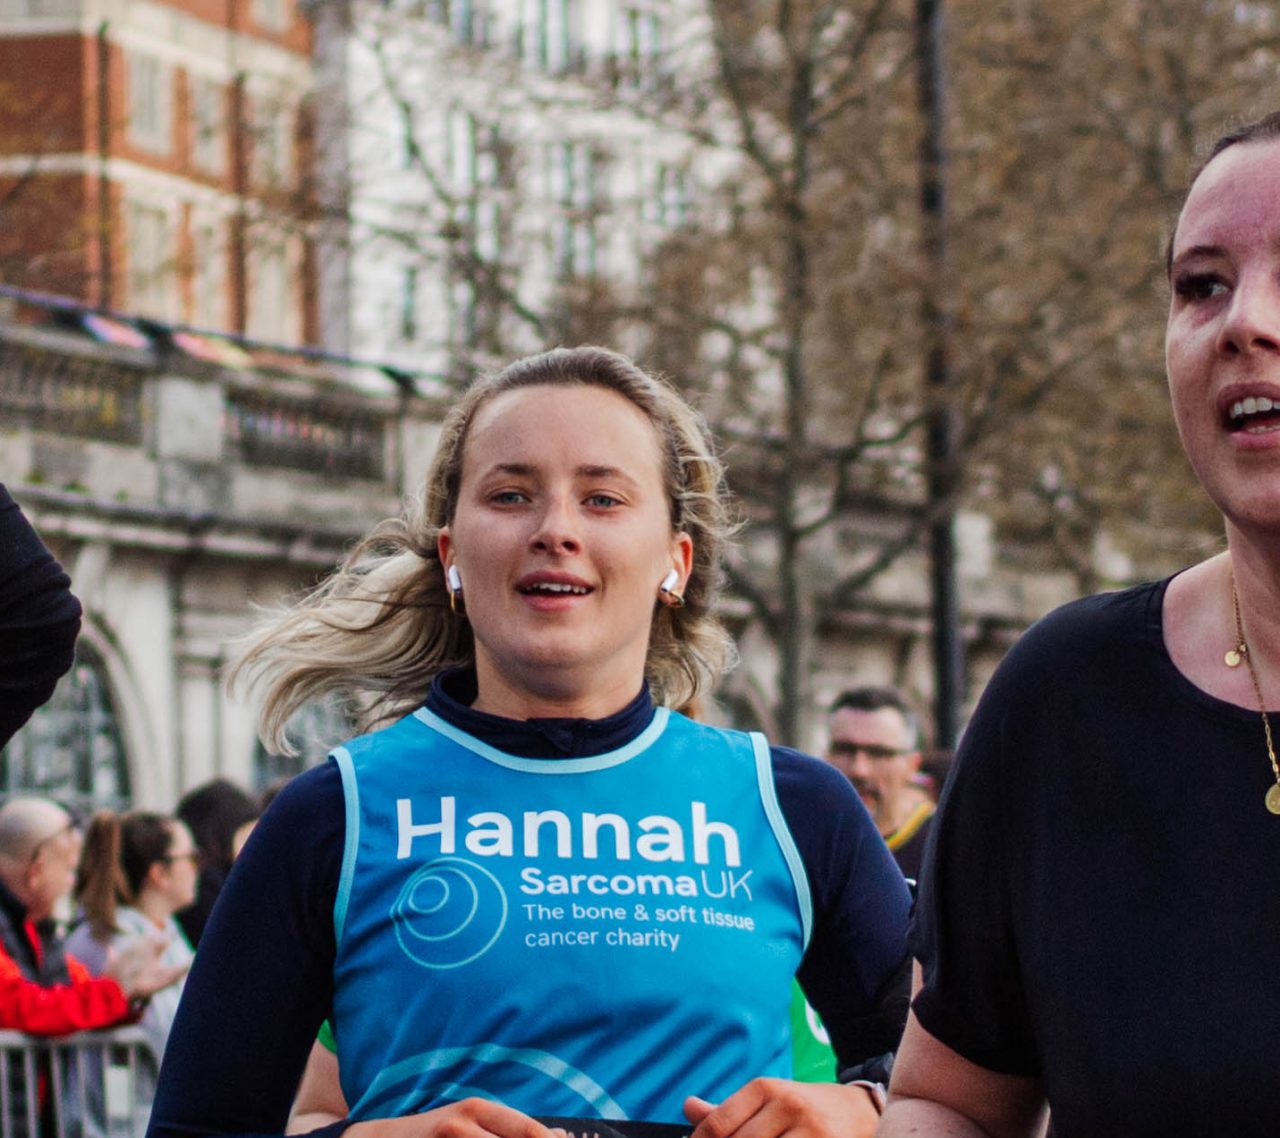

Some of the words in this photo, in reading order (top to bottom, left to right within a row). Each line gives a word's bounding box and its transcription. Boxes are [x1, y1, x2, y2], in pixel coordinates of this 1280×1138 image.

[396, 796, 742, 868] Hannah
[521, 903, 565, 921] The
[572, 903, 627, 922] bone
[634, 904, 650, 923] &
[655, 904, 697, 924] soft
[702, 908, 755, 931] tissue
[524, 928, 599, 948] cancer
[605, 929, 681, 953] charity
